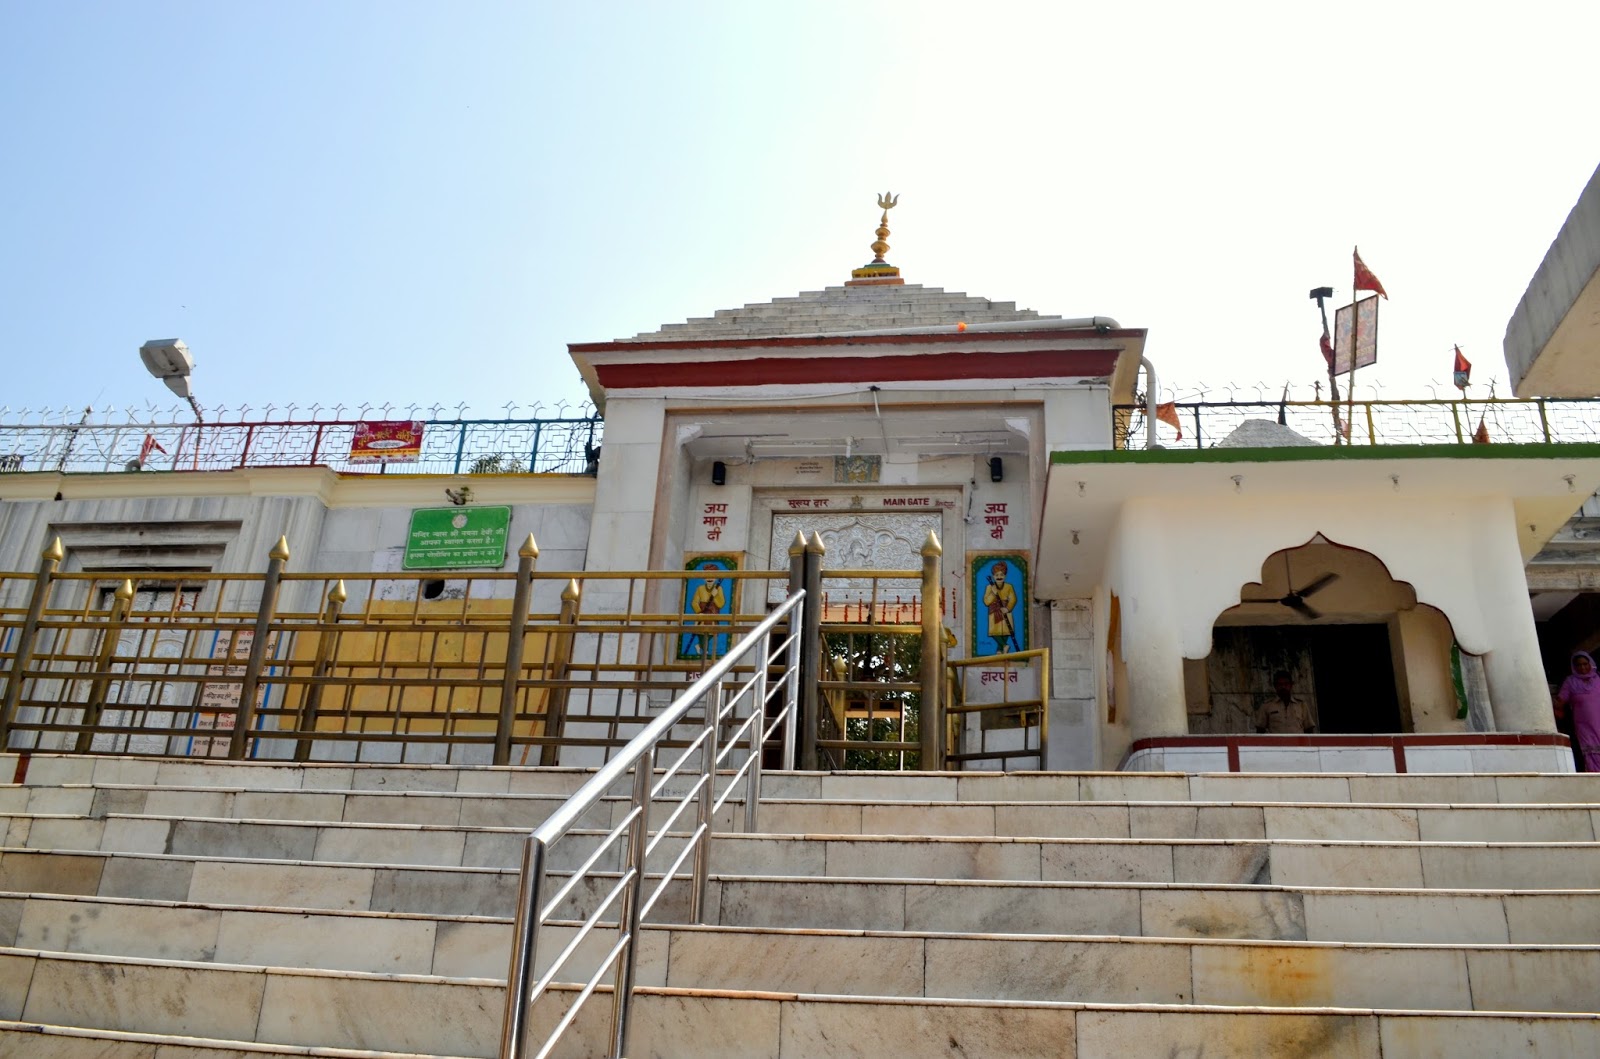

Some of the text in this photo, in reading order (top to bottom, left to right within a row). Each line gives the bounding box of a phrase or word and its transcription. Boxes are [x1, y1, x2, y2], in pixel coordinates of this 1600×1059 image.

[813, 498, 829, 508] द्वार
[883, 498, 906, 506] MAIN
[907, 498, 930, 506] GATE
[704, 503, 729, 514] जय
[984, 503, 1008, 514] जय
[703, 516, 728, 526] माता
[984, 515, 1009, 526] माता
[707, 526, 722, 541] दी
[990, 525, 1004, 540] दी
[980, 671, 1018, 686] द्वारपल
